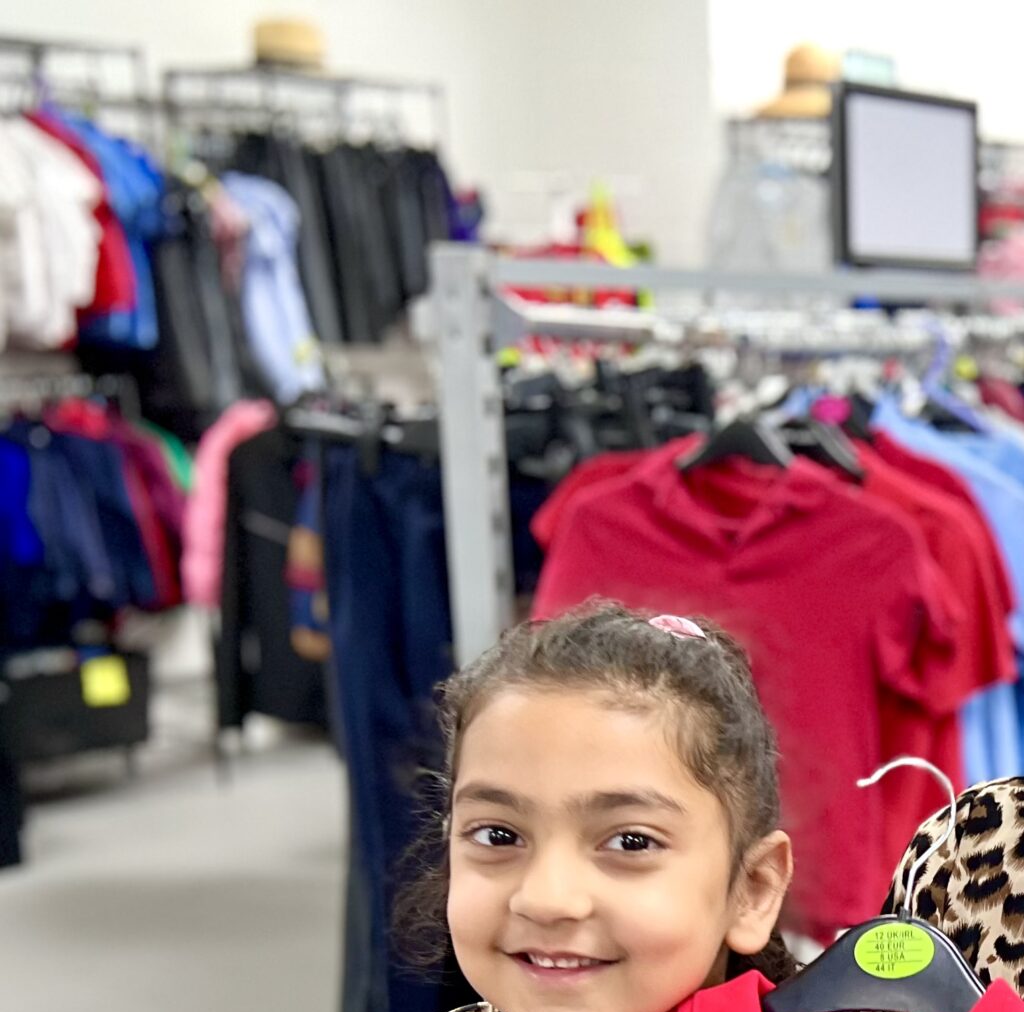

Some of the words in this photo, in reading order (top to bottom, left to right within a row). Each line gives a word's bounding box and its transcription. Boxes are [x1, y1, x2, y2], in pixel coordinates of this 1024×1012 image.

[875, 932, 884, 940] 12
[887, 942, 905, 950] EUR
[887, 952, 905, 961] USA
[875, 964, 885, 972] 44
[888, 963, 895, 971] IT
